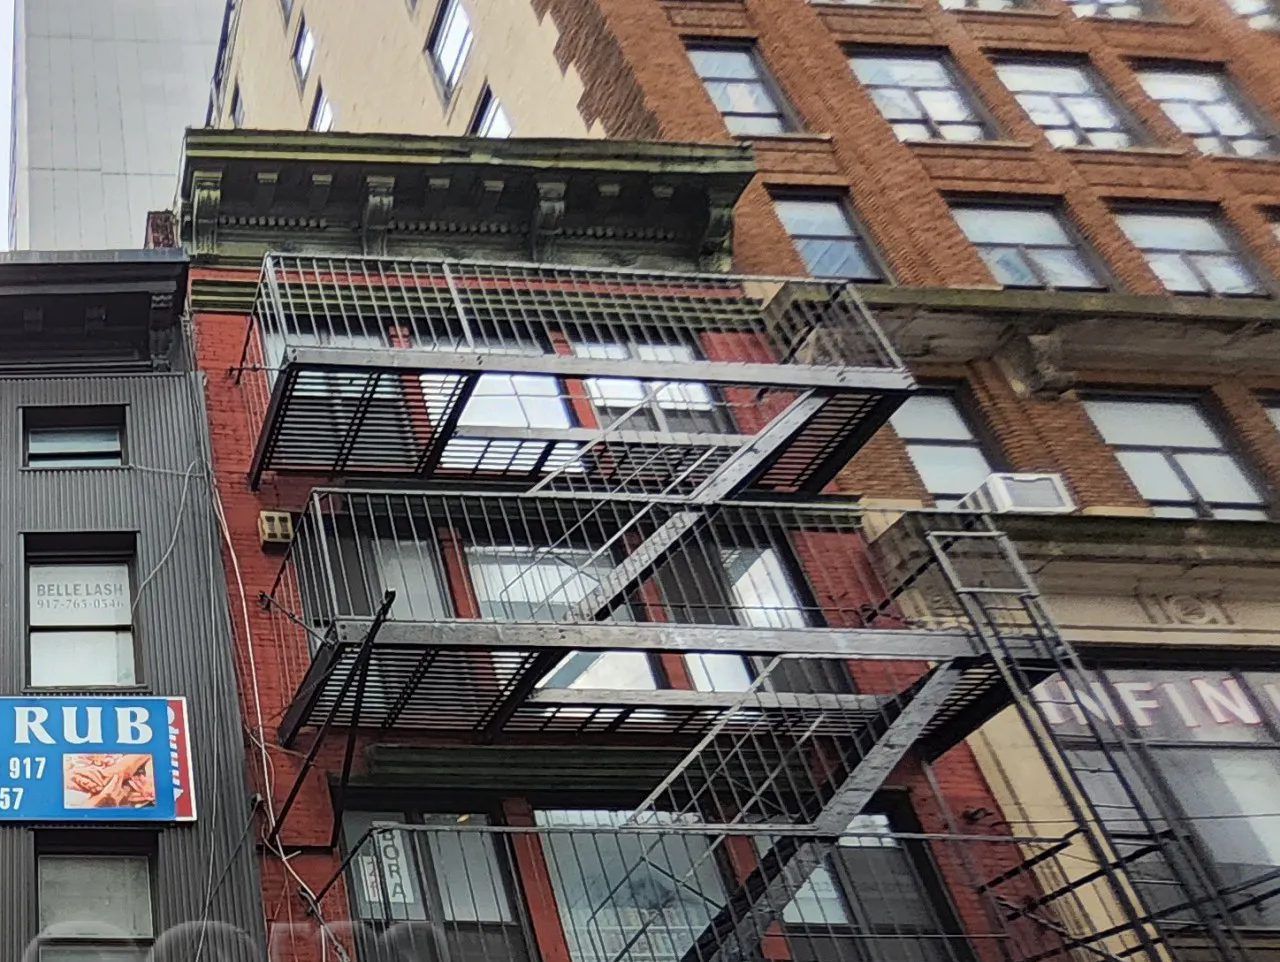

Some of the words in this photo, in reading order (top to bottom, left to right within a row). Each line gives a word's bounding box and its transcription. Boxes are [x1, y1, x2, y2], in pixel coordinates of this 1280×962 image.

[37, 583, 81, 596] BELLE
[85, 584, 123, 597] LASH
[14, 706, 153, 745] RUB
[9, 757, 46, 779] 917
